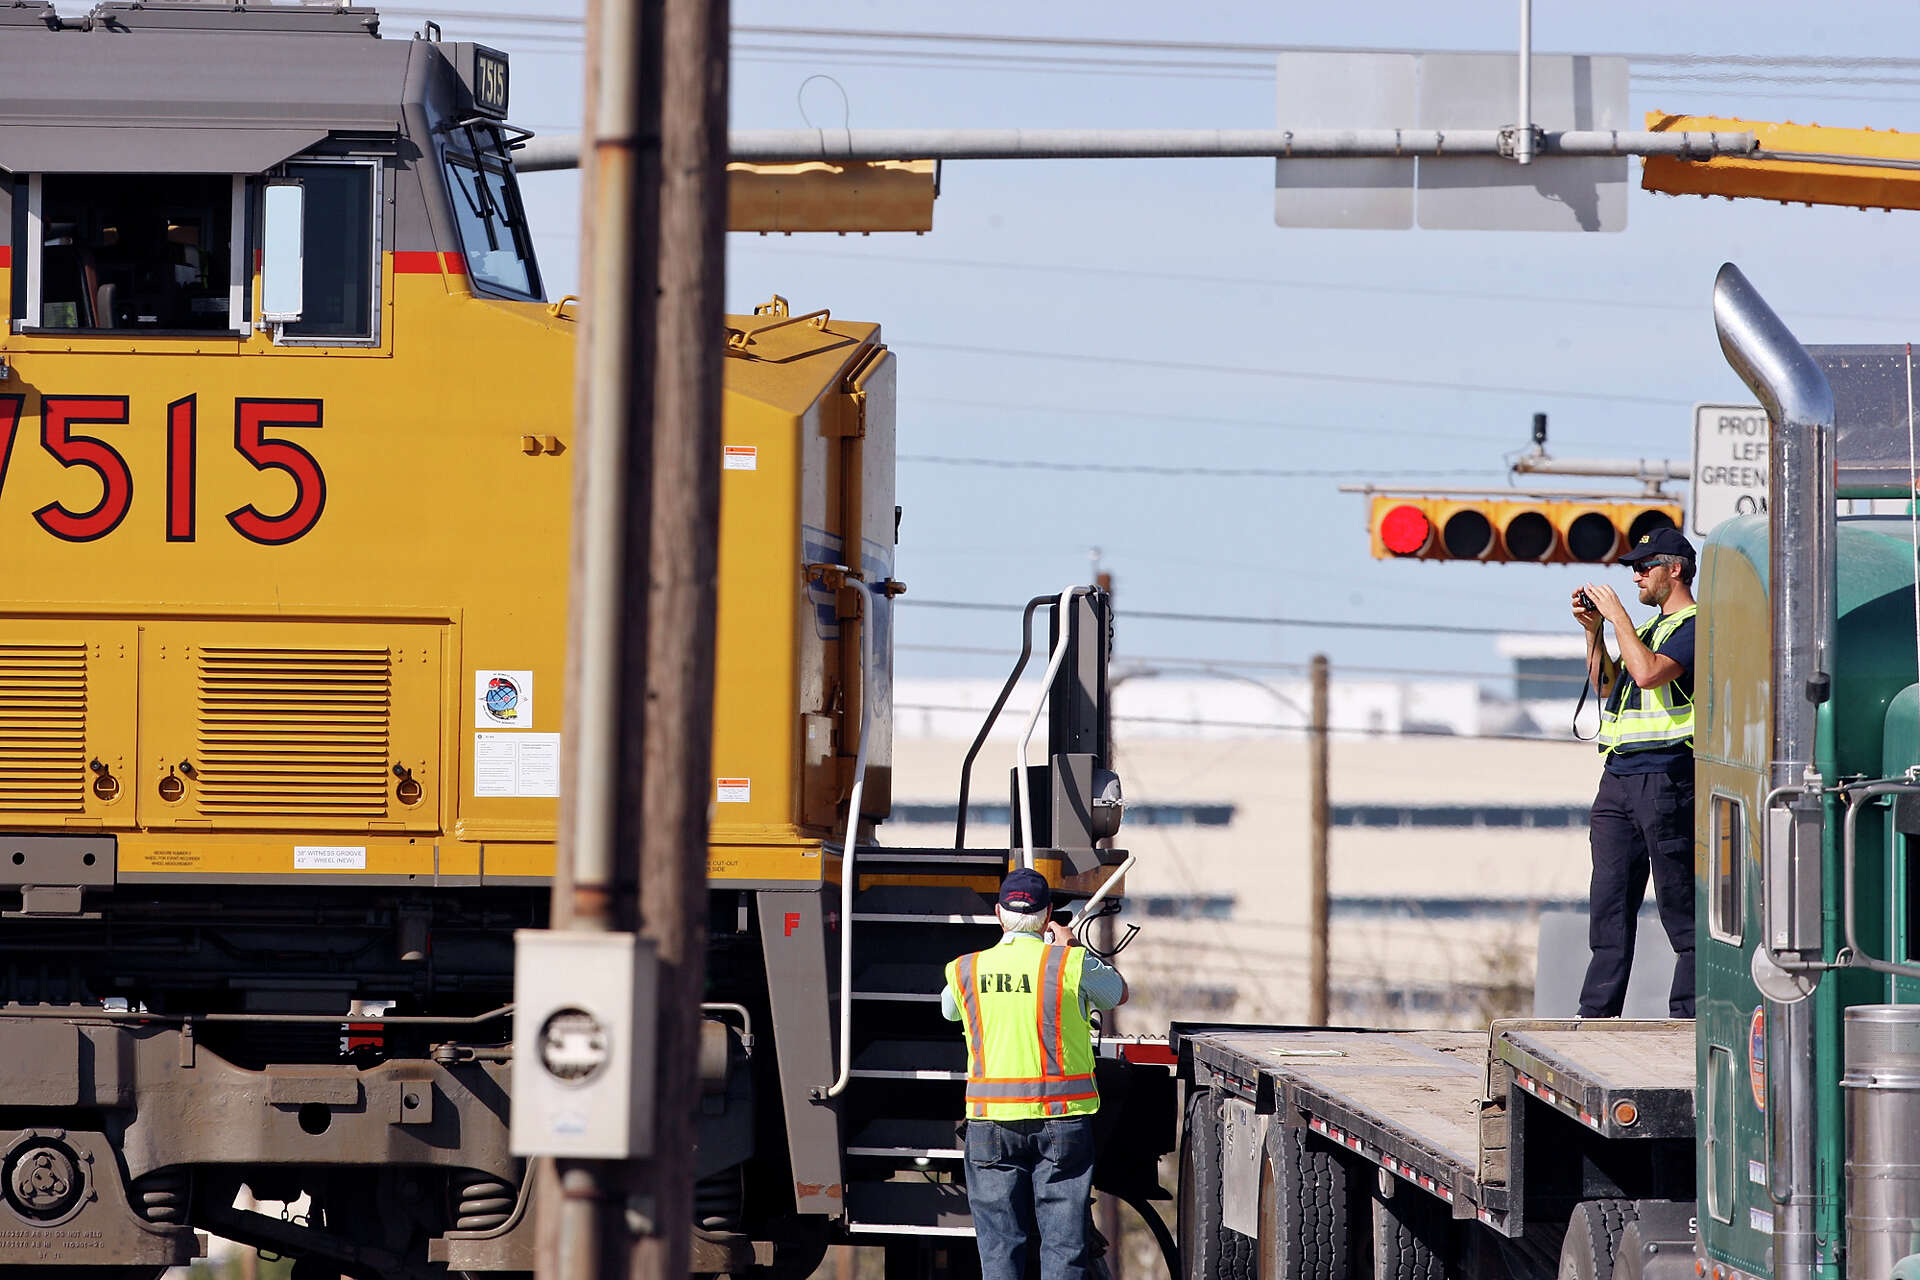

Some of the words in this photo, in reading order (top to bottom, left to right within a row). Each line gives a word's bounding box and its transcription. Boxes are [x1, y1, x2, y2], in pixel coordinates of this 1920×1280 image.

[480, 57, 504, 106] 7515
[1718, 415, 1769, 436] PROT
[1733, 442, 1769, 461] LEF
[0, 392, 327, 546] 515
[784, 912, 800, 937] F
[980, 973, 1032, 994] FRA
